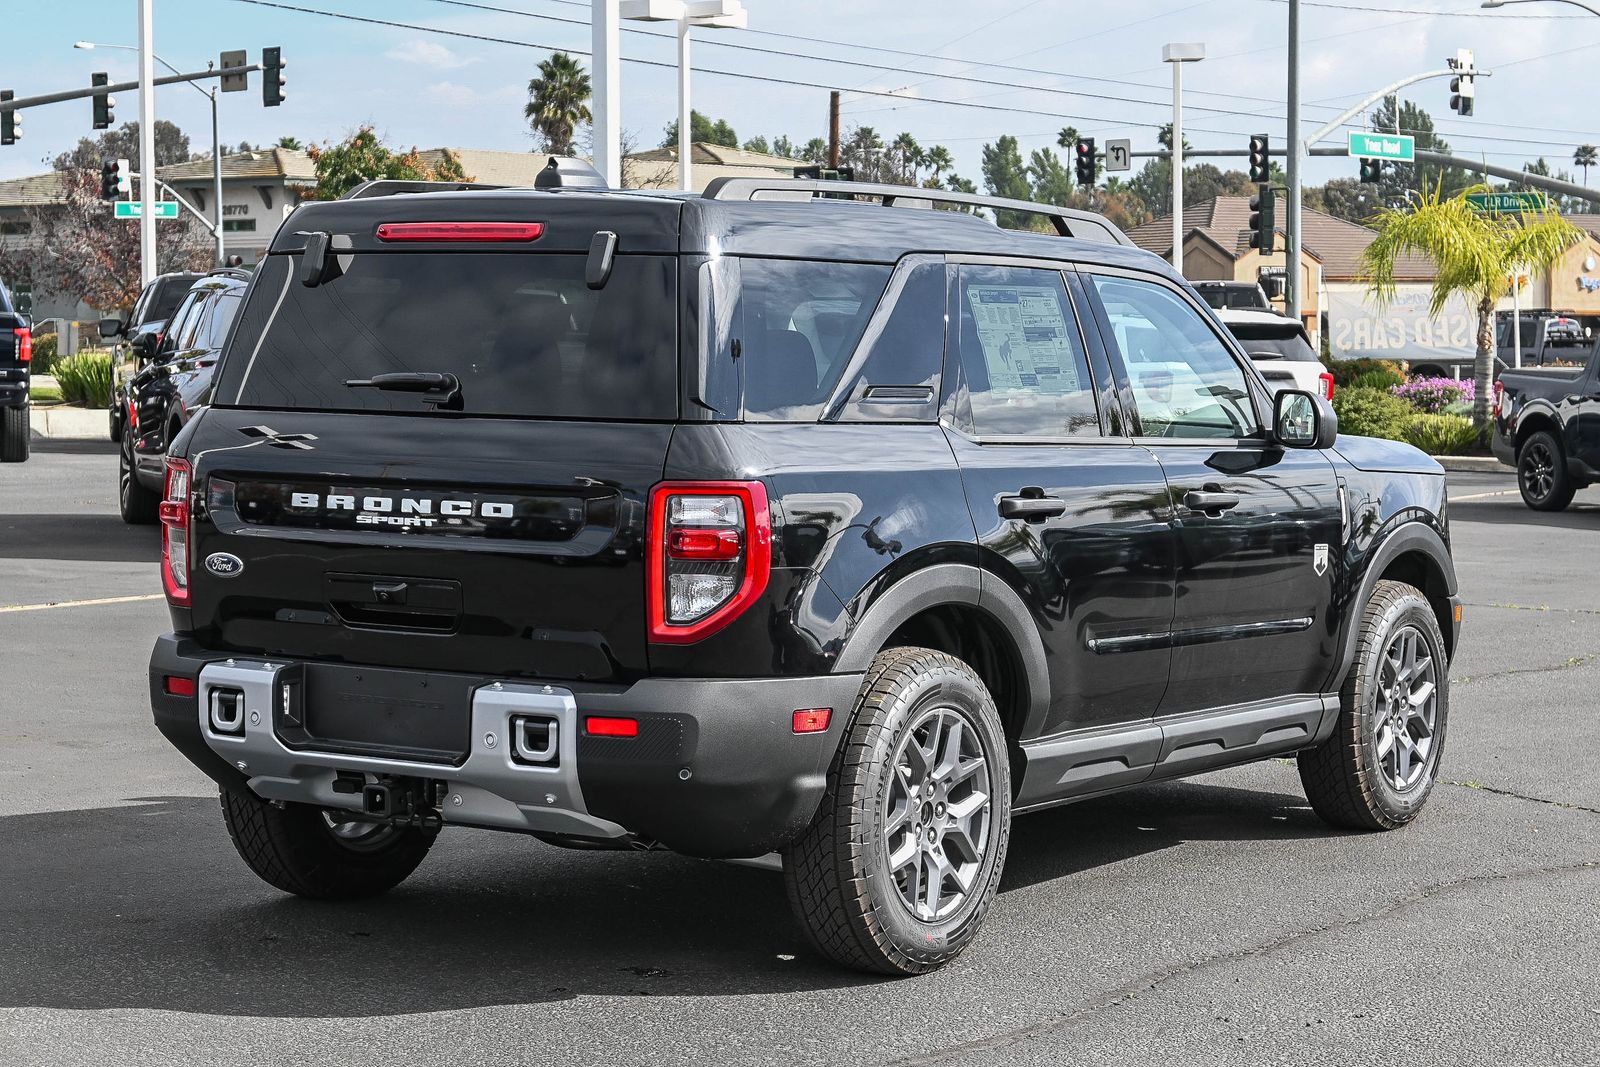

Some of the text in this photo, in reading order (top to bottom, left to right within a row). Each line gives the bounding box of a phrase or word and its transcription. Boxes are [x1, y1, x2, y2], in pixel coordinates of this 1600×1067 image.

[1383, 139, 1401, 155] Road
[291, 492, 514, 518] BRONCO
[356, 515, 438, 527] SPORT
[209, 556, 234, 571] Ford
